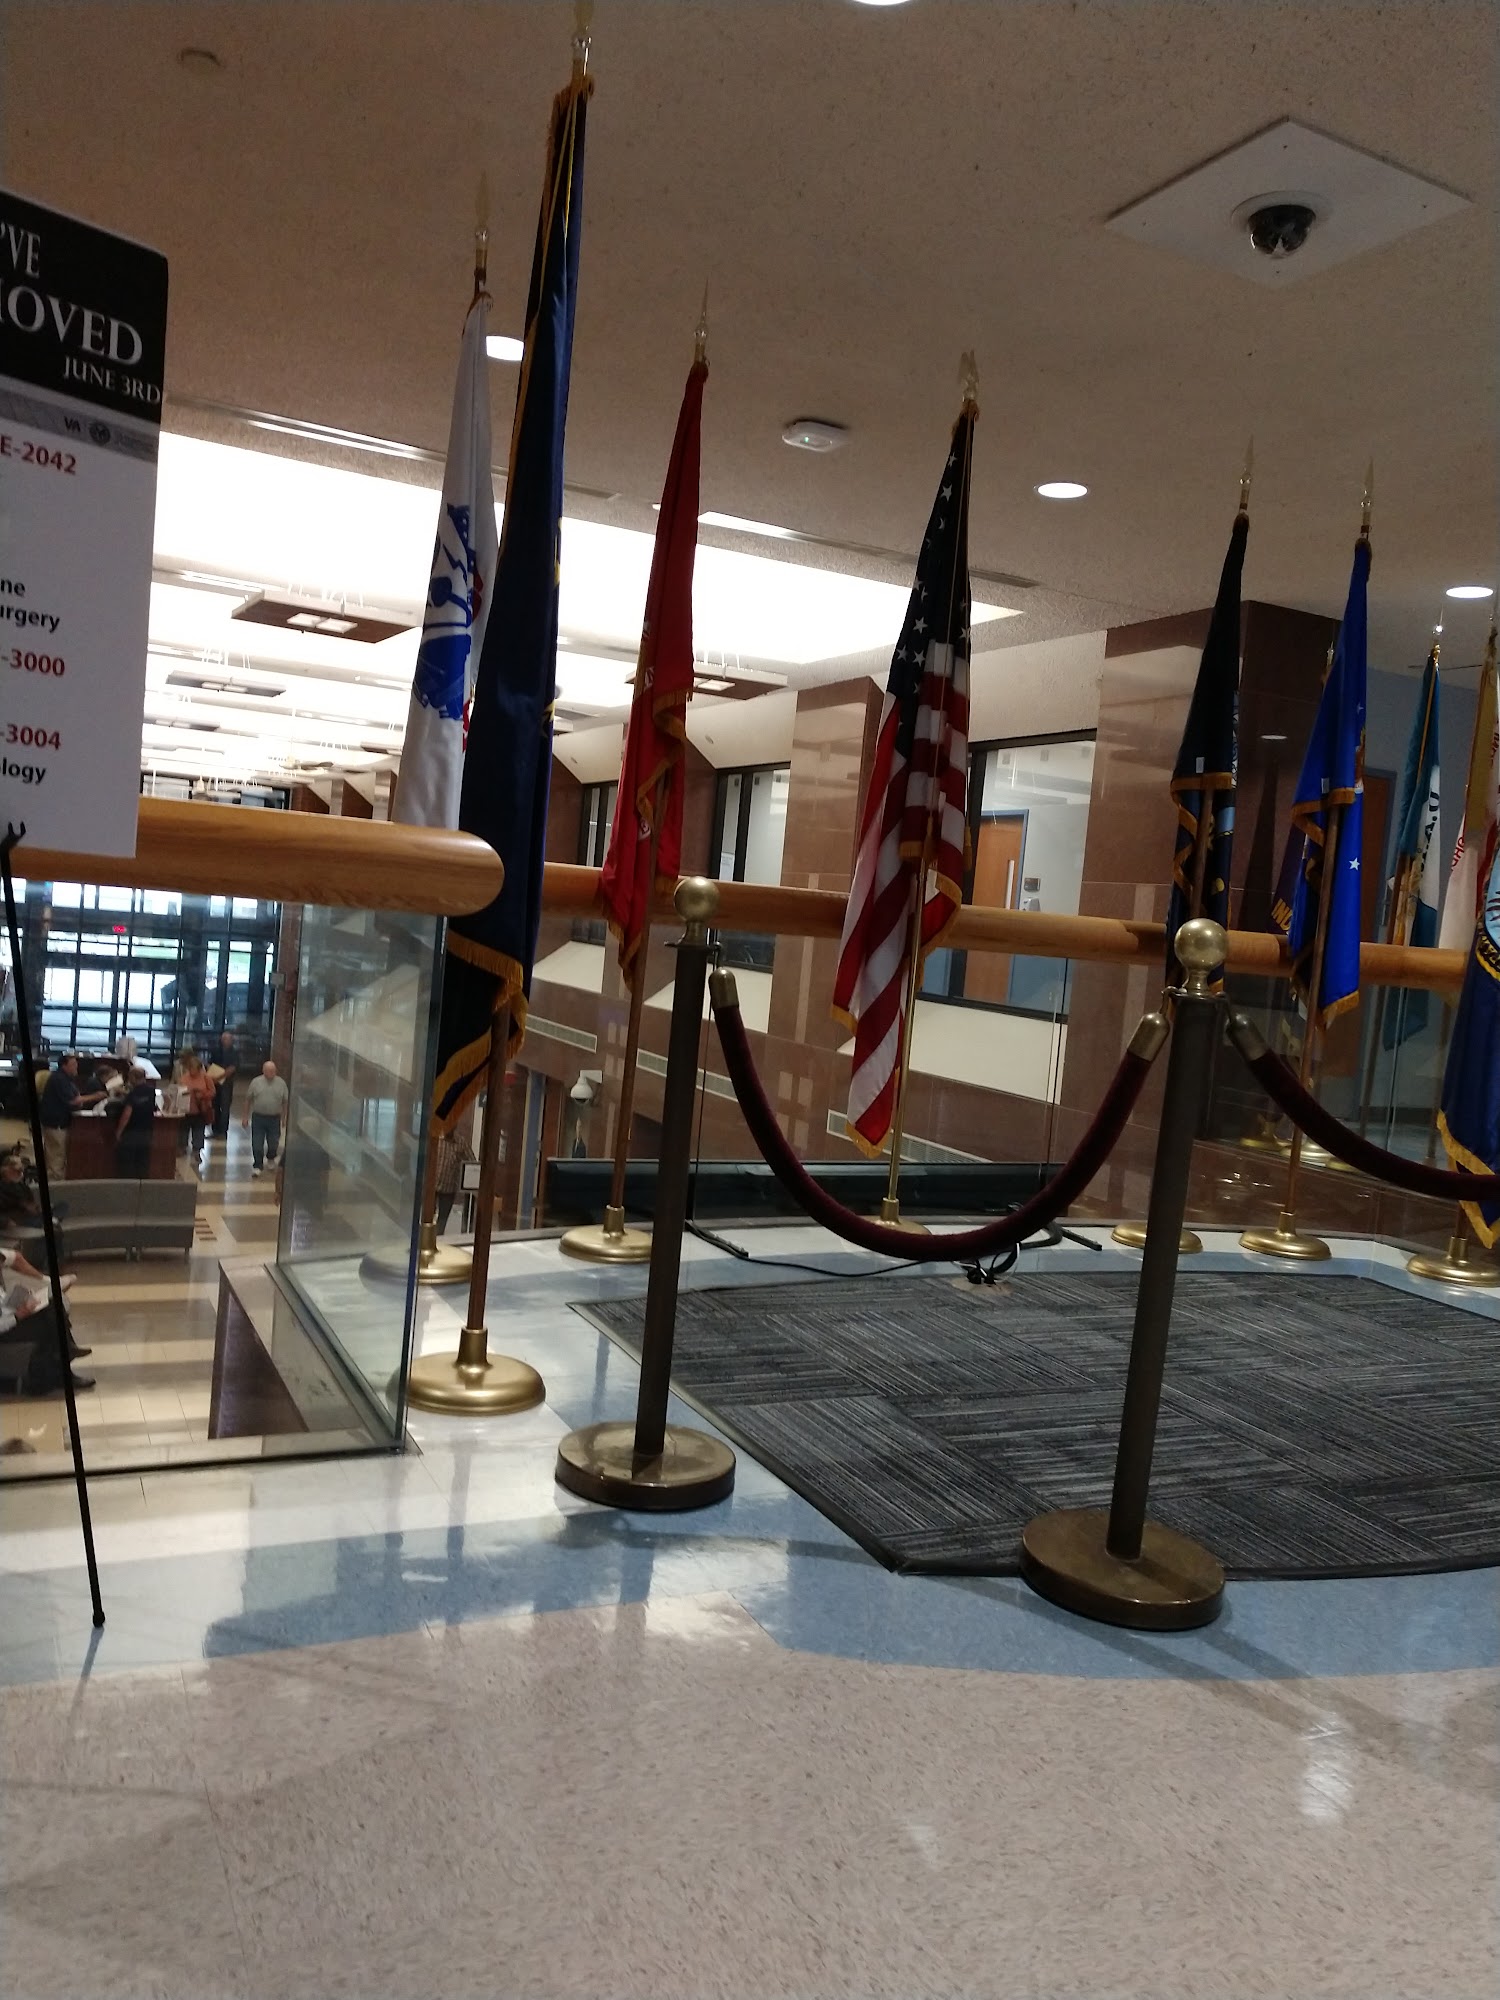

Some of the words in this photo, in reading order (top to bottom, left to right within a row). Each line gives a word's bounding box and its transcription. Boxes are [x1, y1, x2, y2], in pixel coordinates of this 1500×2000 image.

[0, 277, 143, 366] OVED
[63, 355, 117, 390] JUNE
[120, 375, 161, 404] 3RD
[63, 415, 82, 433] VA
[0, 434, 77, 475] E-2042
[0, 578, 25, 597] ne
[0, 757, 46, 785] logy
